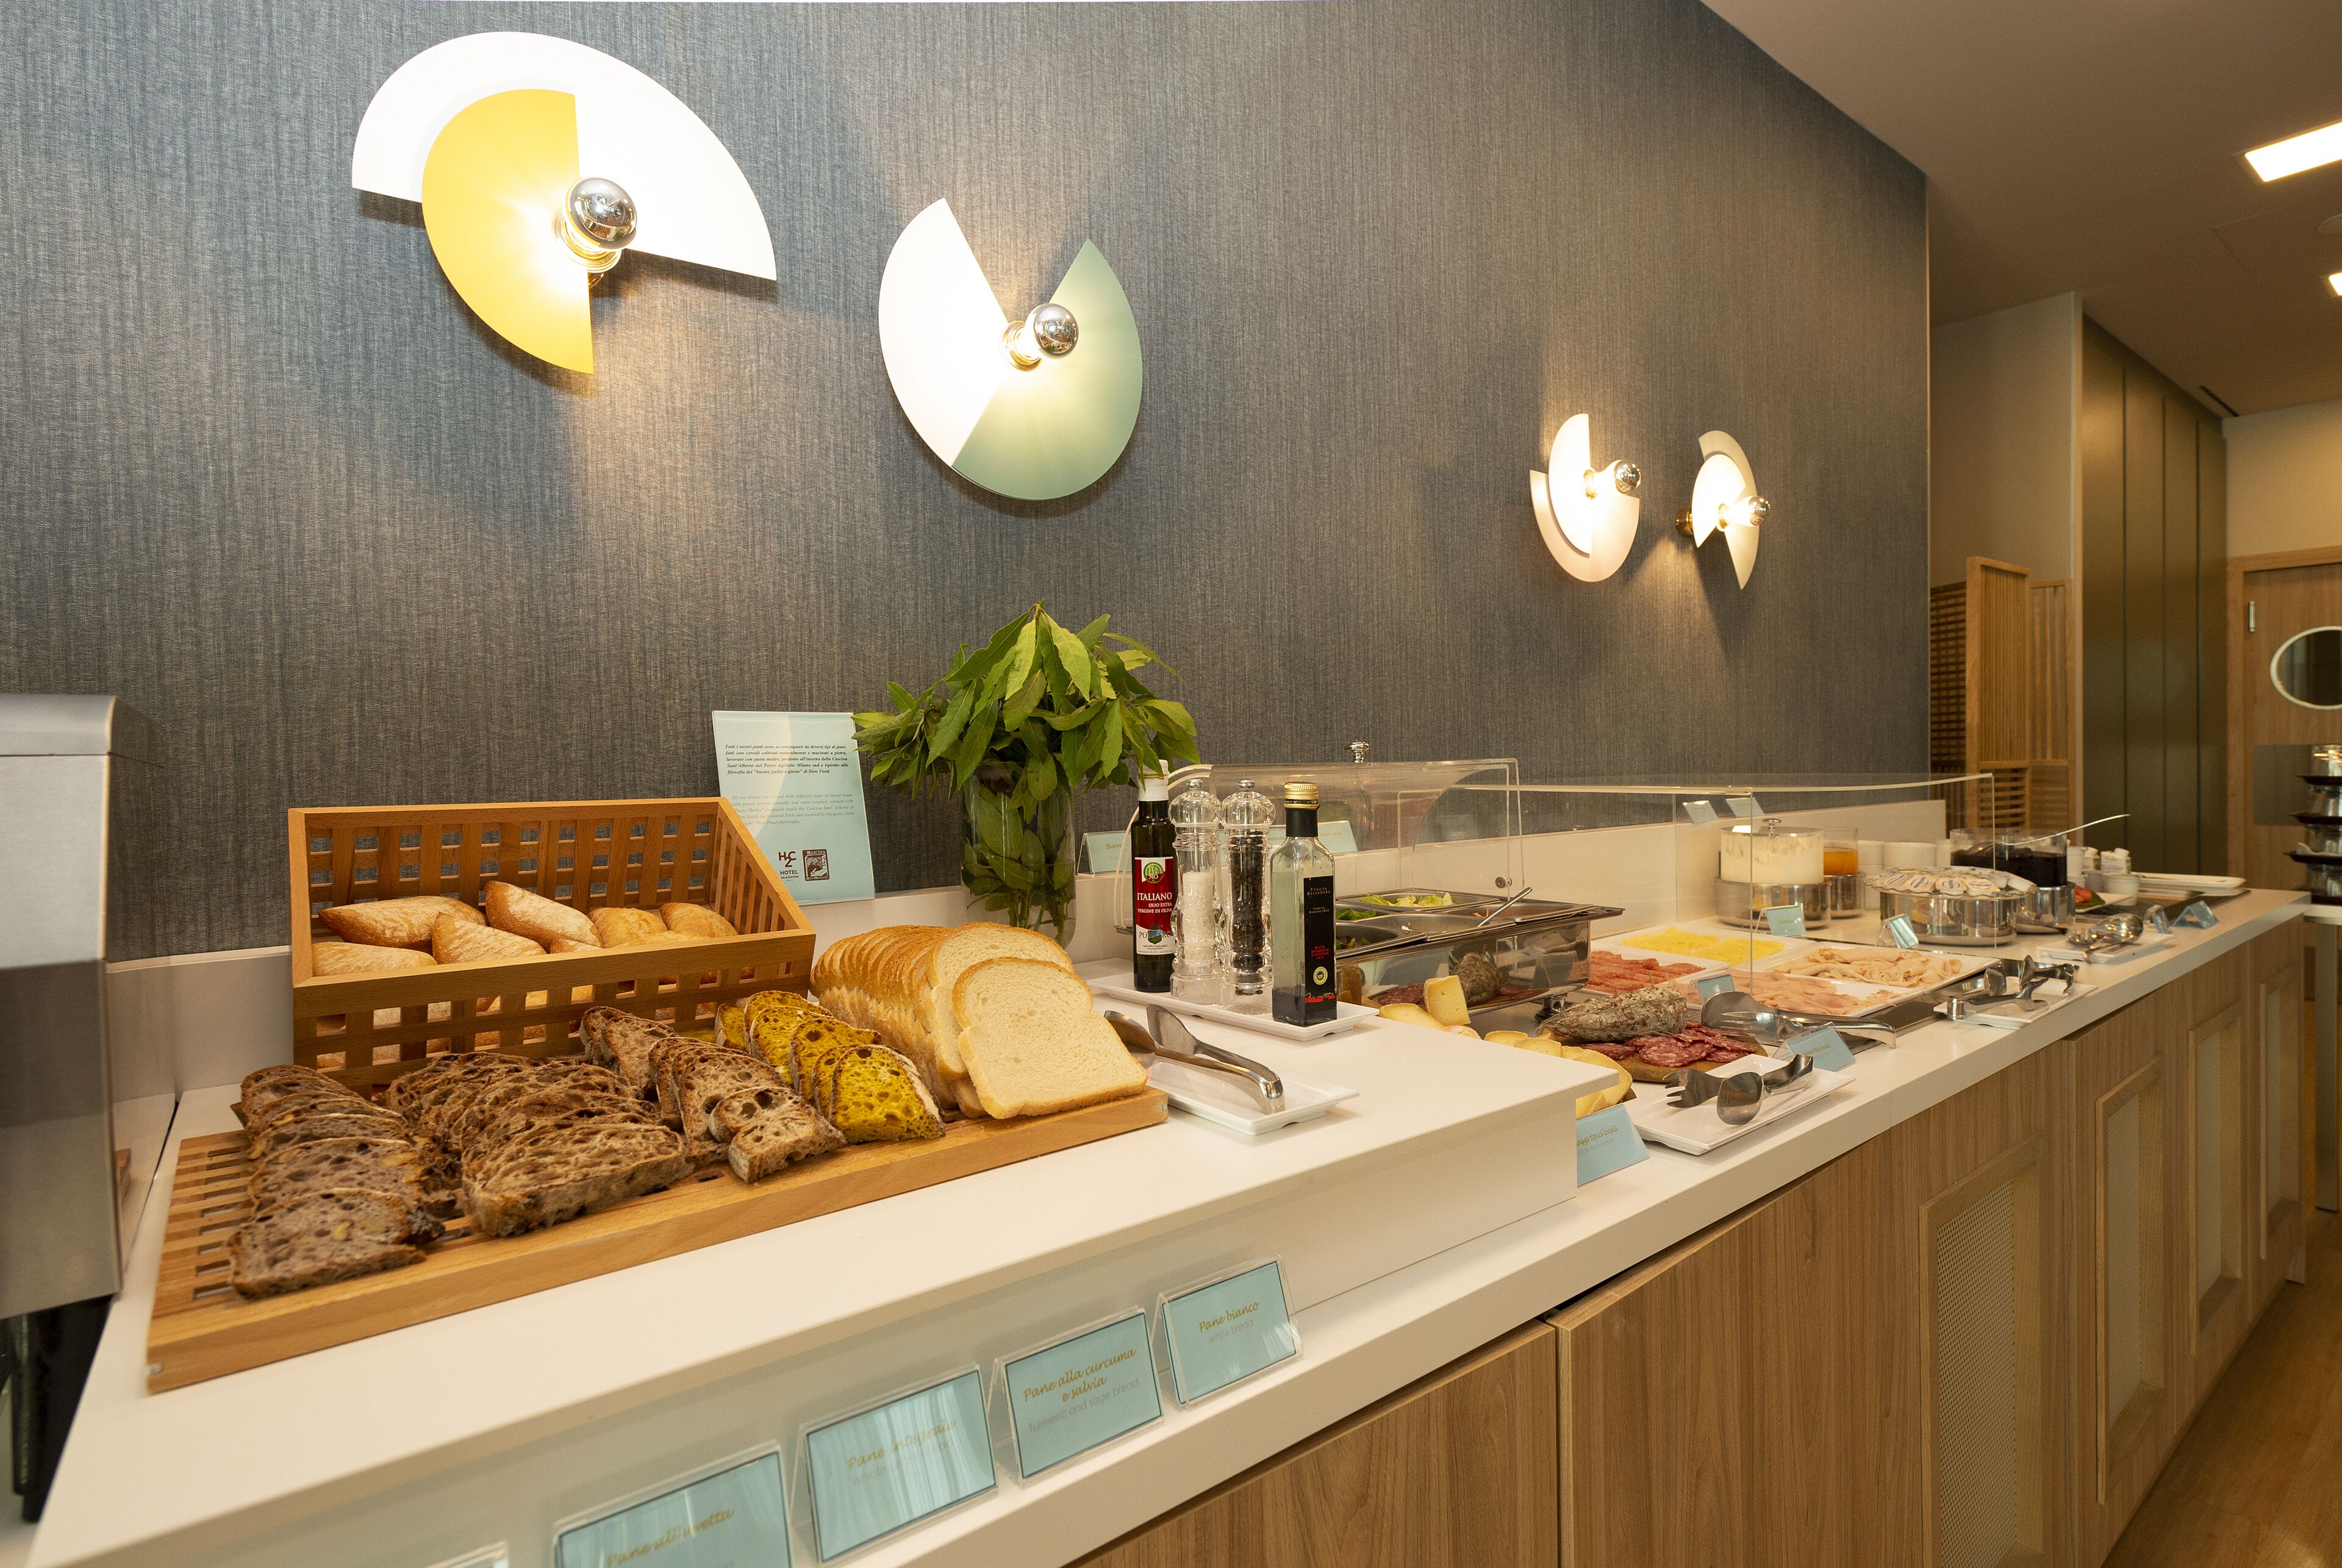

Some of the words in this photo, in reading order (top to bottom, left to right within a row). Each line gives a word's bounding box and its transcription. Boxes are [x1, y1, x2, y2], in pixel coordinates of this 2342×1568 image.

[1137, 892, 1172, 901] ITALIANO
[1198, 1316, 1226, 1334] Pane
[1226, 1301, 1260, 1322] bianco
[1209, 1328, 1230, 1342] white
[1231, 1317, 1254, 1334] bread
[1023, 1381, 1057, 1403] Pane
[1058, 1369, 1084, 1387] alla
[1084, 1348, 1137, 1376] curcuma
[1062, 1392, 1070, 1403] e
[1071, 1375, 1108, 1400] salvia
[1069, 1399, 1087, 1416] and
[1112, 1378, 1139, 1397] bread
[848, 1447, 887, 1471] Pane
[606, 1544, 652, 1568] Pane
